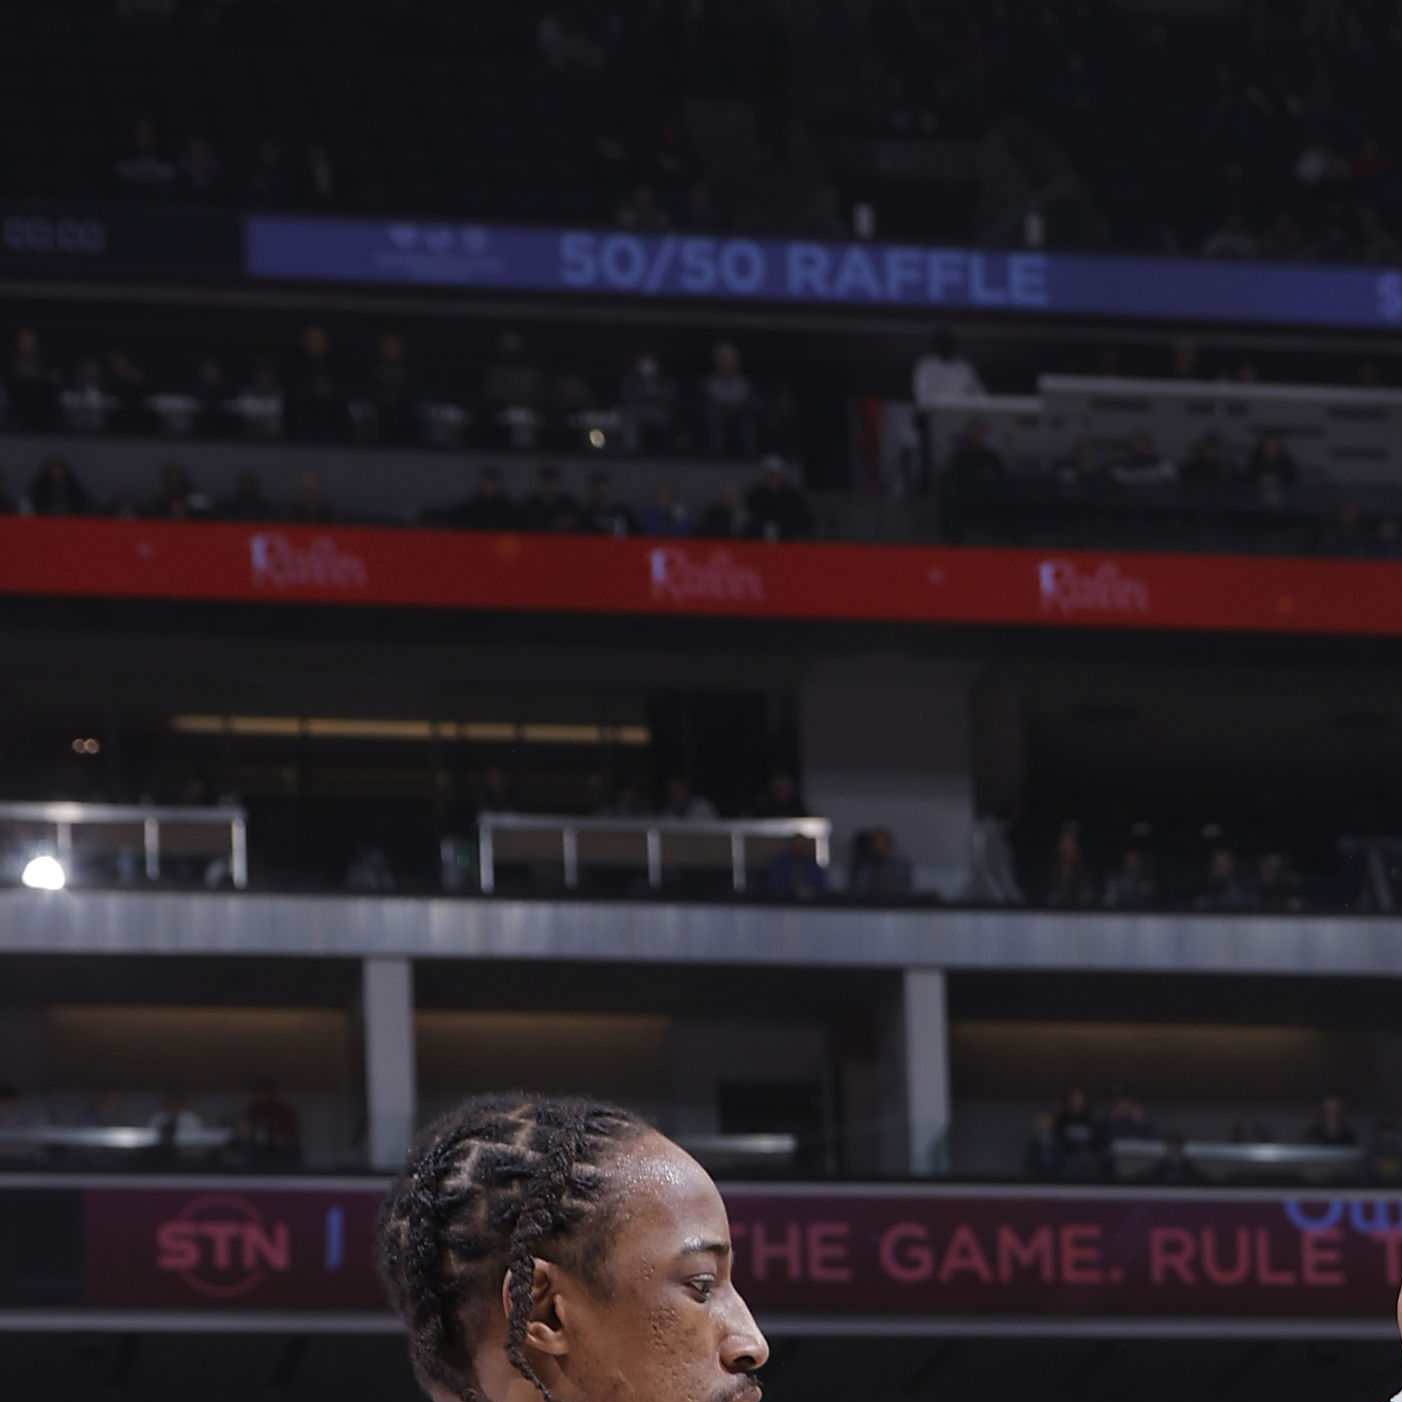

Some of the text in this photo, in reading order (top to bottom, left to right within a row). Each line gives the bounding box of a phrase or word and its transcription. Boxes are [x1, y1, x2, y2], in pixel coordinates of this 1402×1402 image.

[560, 230, 767, 295] 50/50
[785, 240, 1050, 307] RAFFLE
[156, 1220, 290, 1272] STN
[878, 1223, 1122, 1287] GAME.
[1149, 1225, 1347, 1287] RULE
